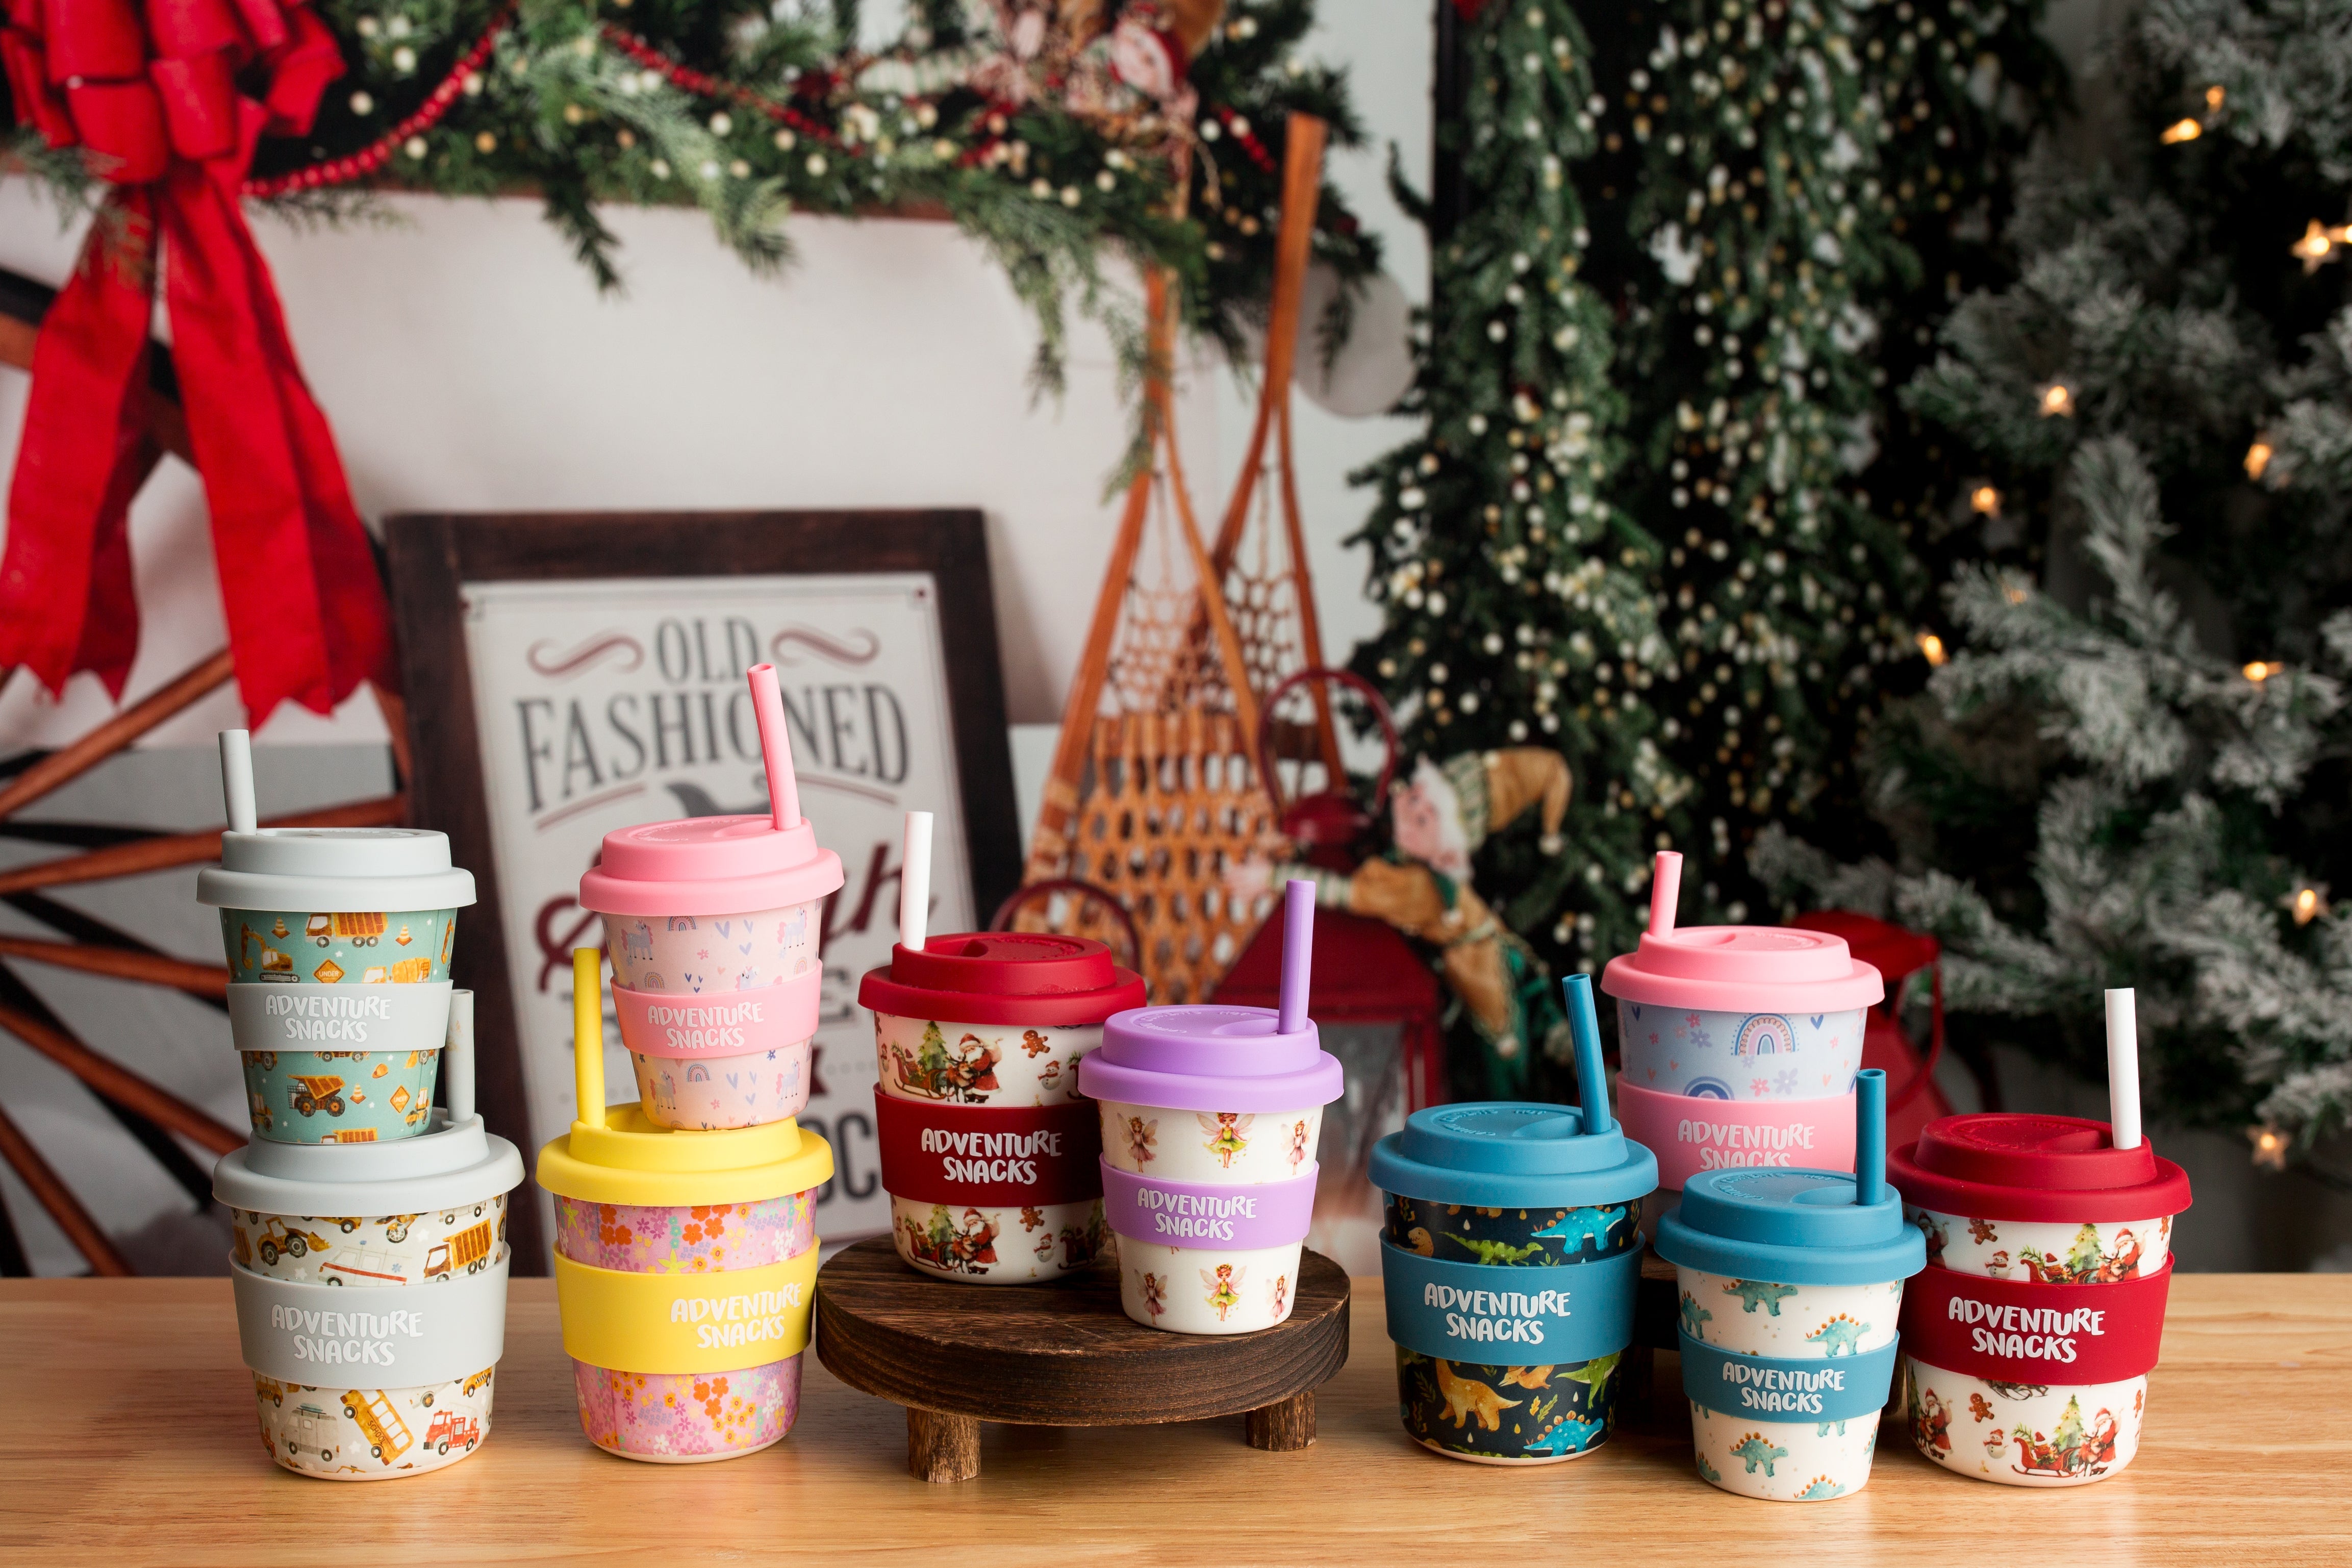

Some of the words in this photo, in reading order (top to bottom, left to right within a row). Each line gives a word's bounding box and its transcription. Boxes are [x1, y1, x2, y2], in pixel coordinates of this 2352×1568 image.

[655, 616, 760, 686] OLD
[515, 682, 910, 813] FASHIONED
[265, 995, 391, 1020] ADVENTURE
[647, 1001, 764, 1027] ADVENTURE
[285, 1019, 367, 1042] SNACKS
[666, 1027, 745, 1049] SNACKS
[921, 1128, 1063, 1158] ADVENTURE
[1678, 1119, 1815, 1150] ADVENTURE
[944, 1156, 1037, 1185] SNACKS
[1700, 1147, 1790, 1171] SNACKS
[1137, 1187, 1258, 1219] ADVENTURE
[1155, 1212, 1234, 1241] SNACKS
[670, 1282, 802, 1323] ADVENTURE
[1424, 1282, 1571, 1318] ADVENTURE
[1949, 1297, 2105, 1335] ADVENTURE
[271, 1304, 423, 1339] ADVENTURE
[697, 1315, 785, 1348] SNACKS
[1446, 1312, 1544, 1345] SNACKS
[293, 1334, 395, 1367] SNACKS
[1972, 1328, 2077, 1363] SNACKS
[1723, 1361, 1845, 1393] ADVENTURE
[1741, 1386, 1823, 1414] SNACKS
[367, 1420, 386, 1445] SCHOOL
